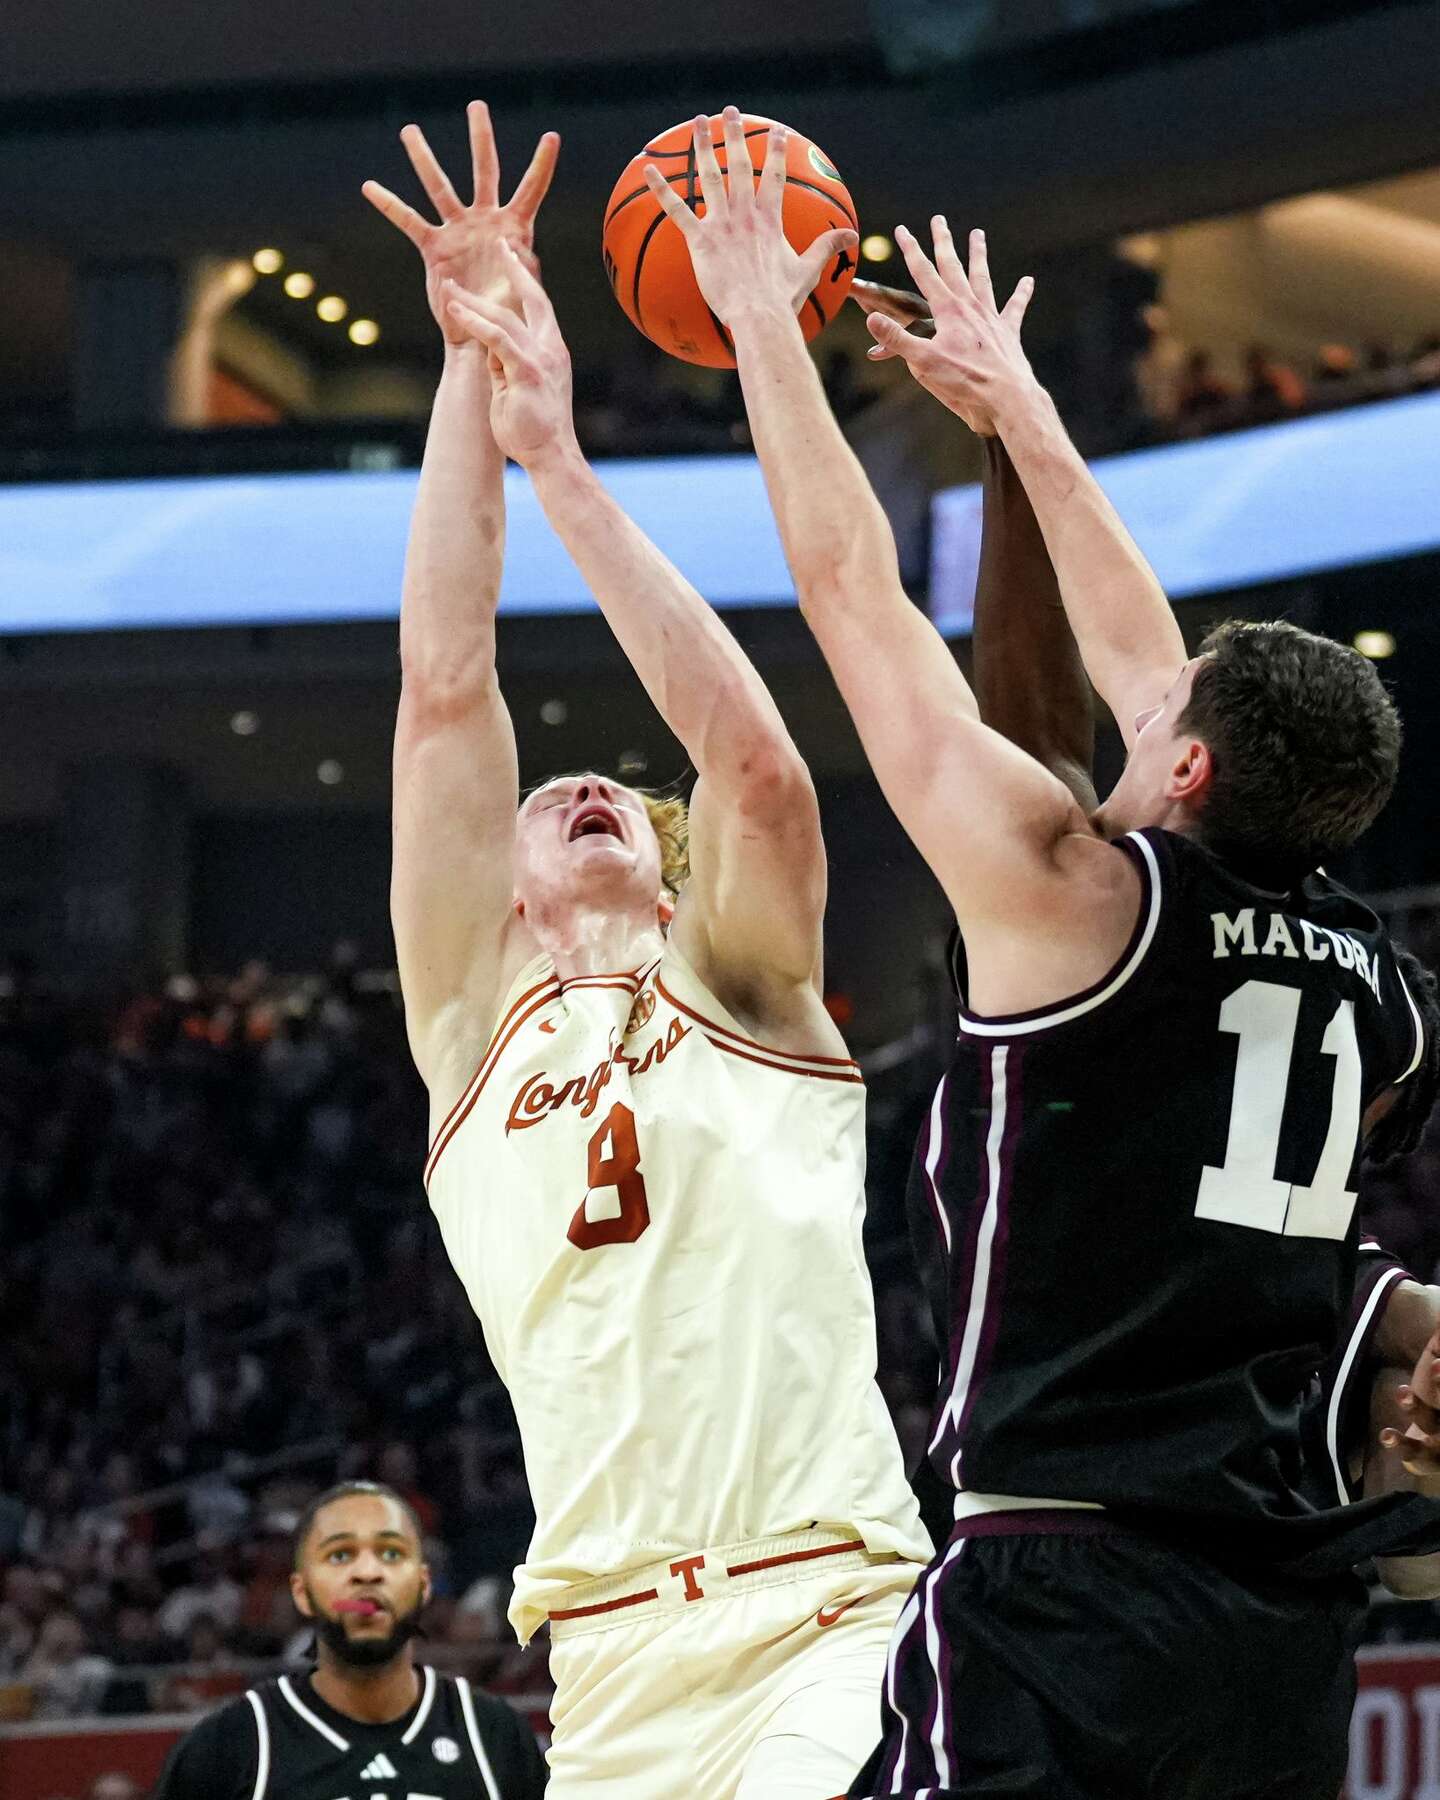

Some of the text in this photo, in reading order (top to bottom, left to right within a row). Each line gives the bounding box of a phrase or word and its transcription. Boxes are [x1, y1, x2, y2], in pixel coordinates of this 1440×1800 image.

[567, 1101, 651, 1250] 8
[1194, 980, 1363, 1241] 11
[669, 1554, 705, 1602] T
